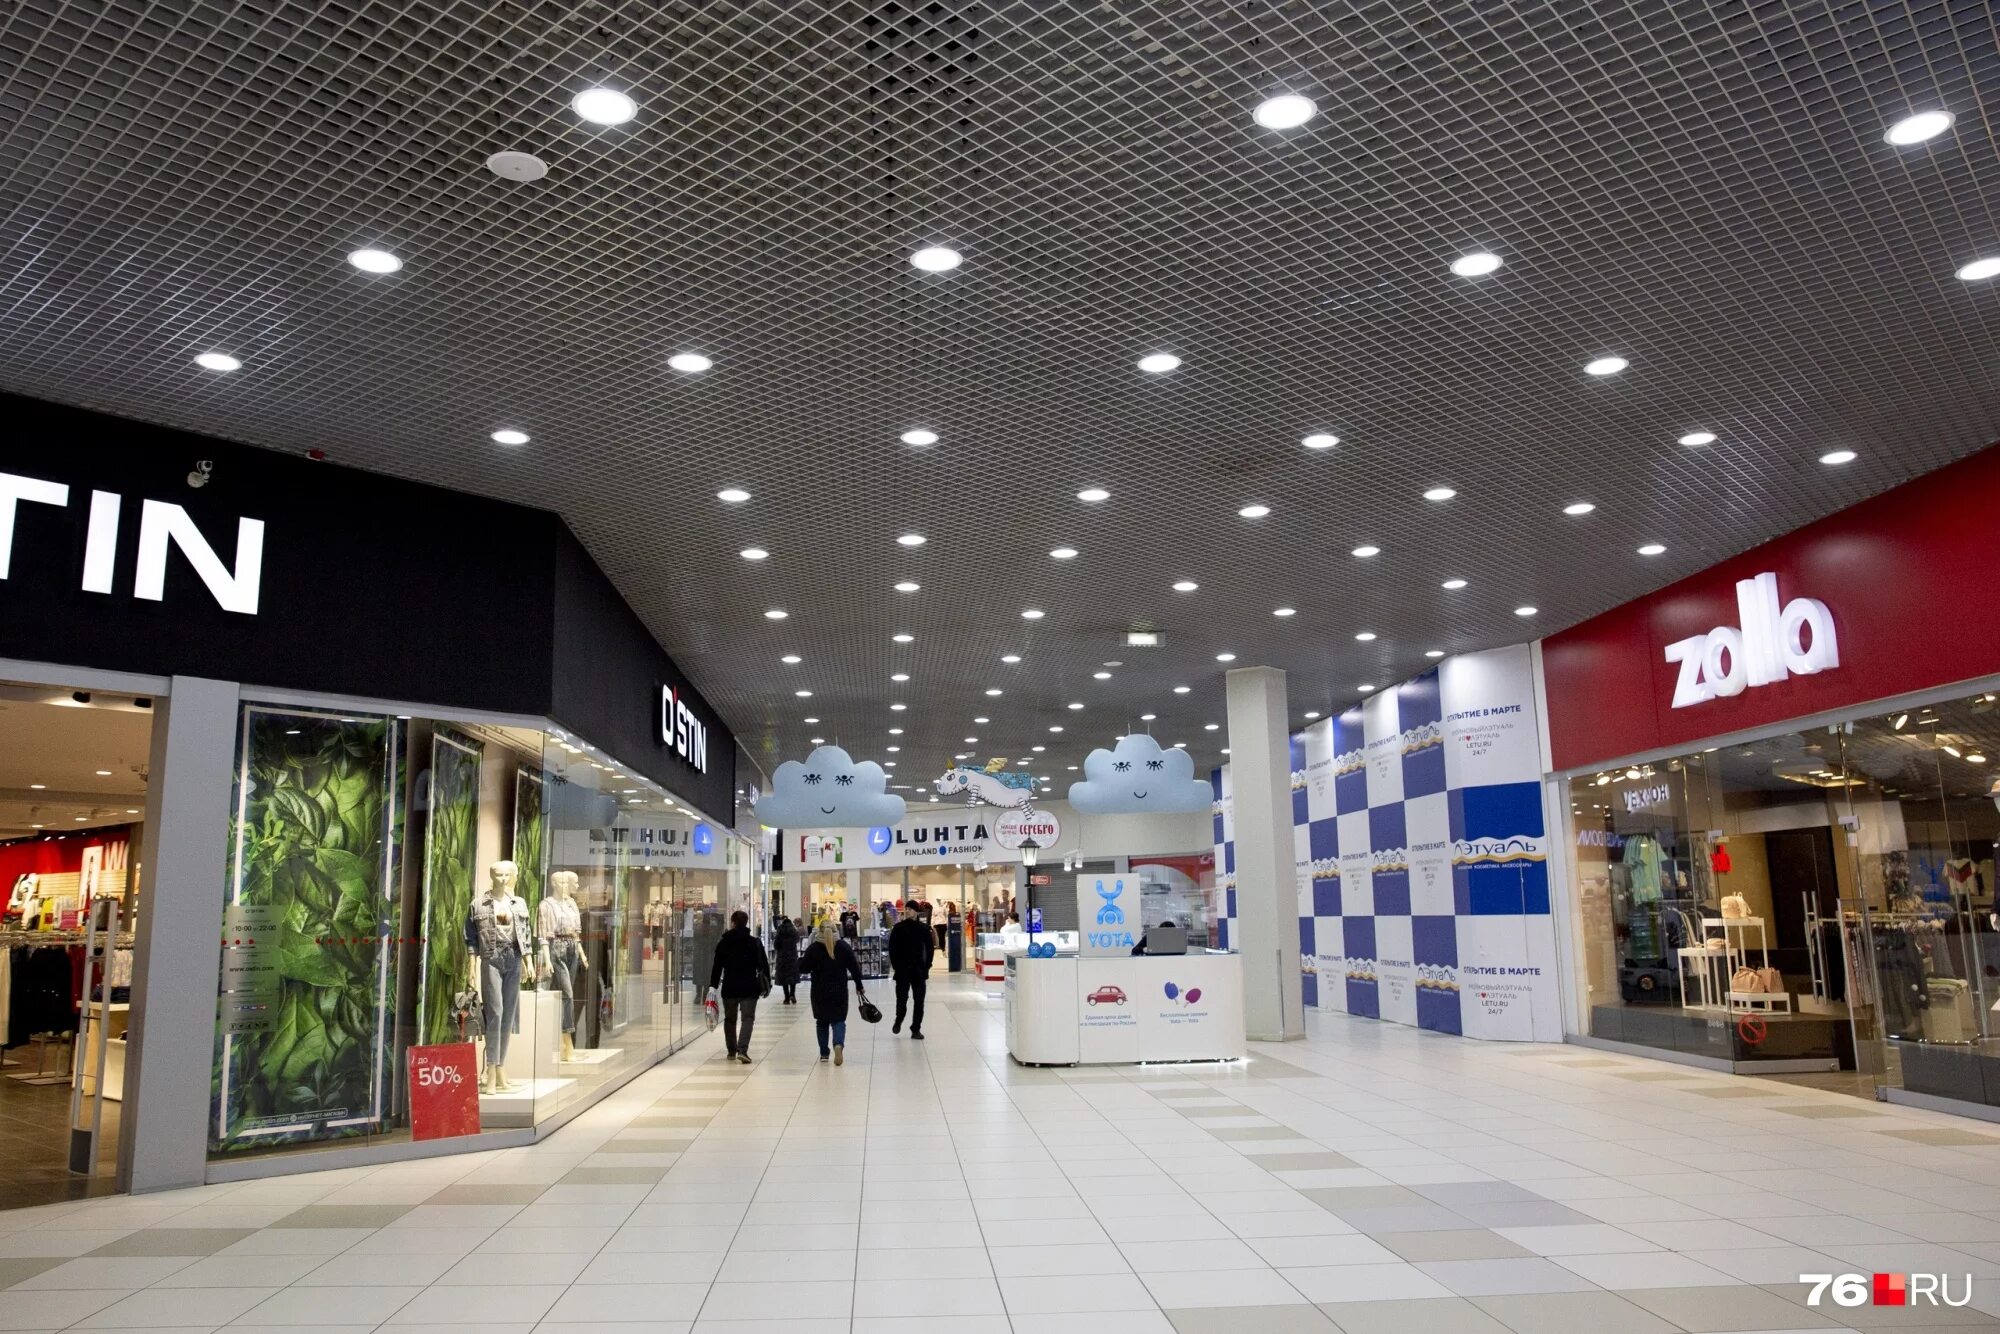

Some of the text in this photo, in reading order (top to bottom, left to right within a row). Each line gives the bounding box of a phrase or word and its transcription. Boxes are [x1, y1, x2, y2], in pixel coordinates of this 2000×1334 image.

[1664, 572, 1839, 709] zolla
[1491, 705, 1521, 715] МАРТЕ
[662, 684, 707, 774] O'STIN
[1466, 741, 1492, 749] LETU.RU
[896, 824, 989, 844] LUHTA
[905, 846, 937, 856] FINLAND
[1088, 931, 1134, 948] YOTA
[1508, 968, 1541, 976] МАРТЕ
[419, 1065, 462, 1086] 50%
